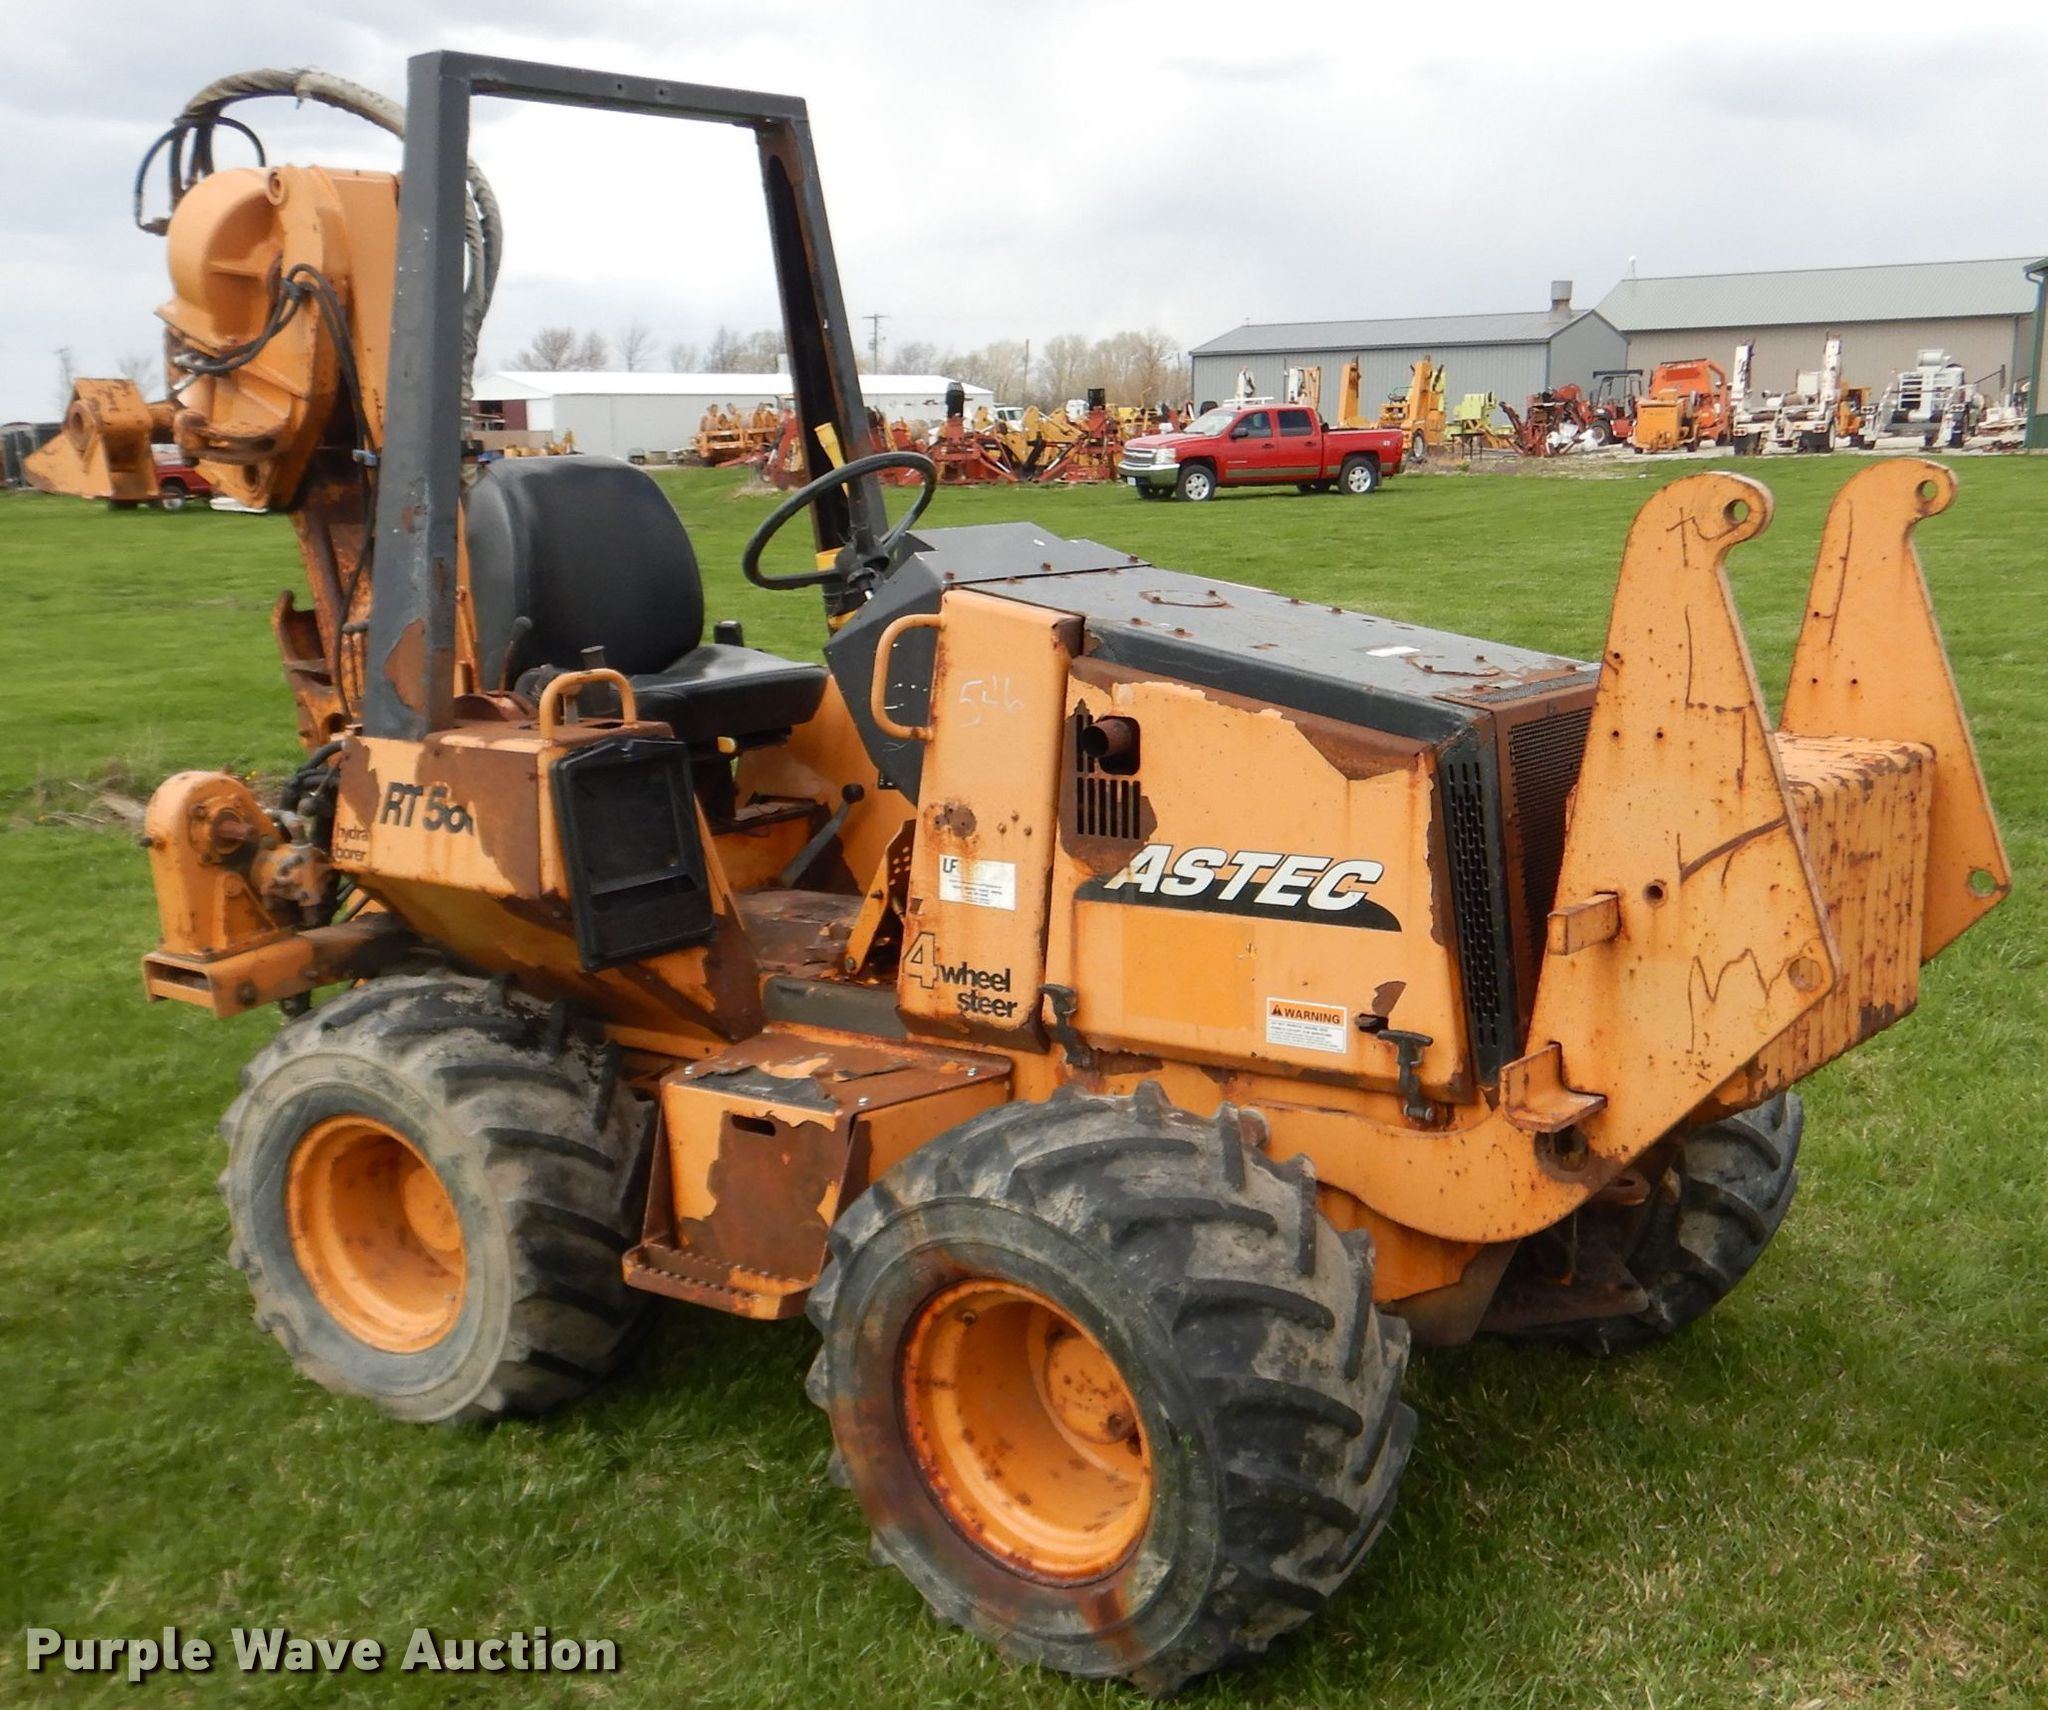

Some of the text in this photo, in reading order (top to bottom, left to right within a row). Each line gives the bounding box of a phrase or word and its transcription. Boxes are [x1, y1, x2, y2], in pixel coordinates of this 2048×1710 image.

[1102, 843, 1385, 912] ASTEC
[902, 931, 1011, 993] 4 wheel
[957, 989, 1018, 1018] steer
[1284, 1008, 1341, 1024] WARNING
